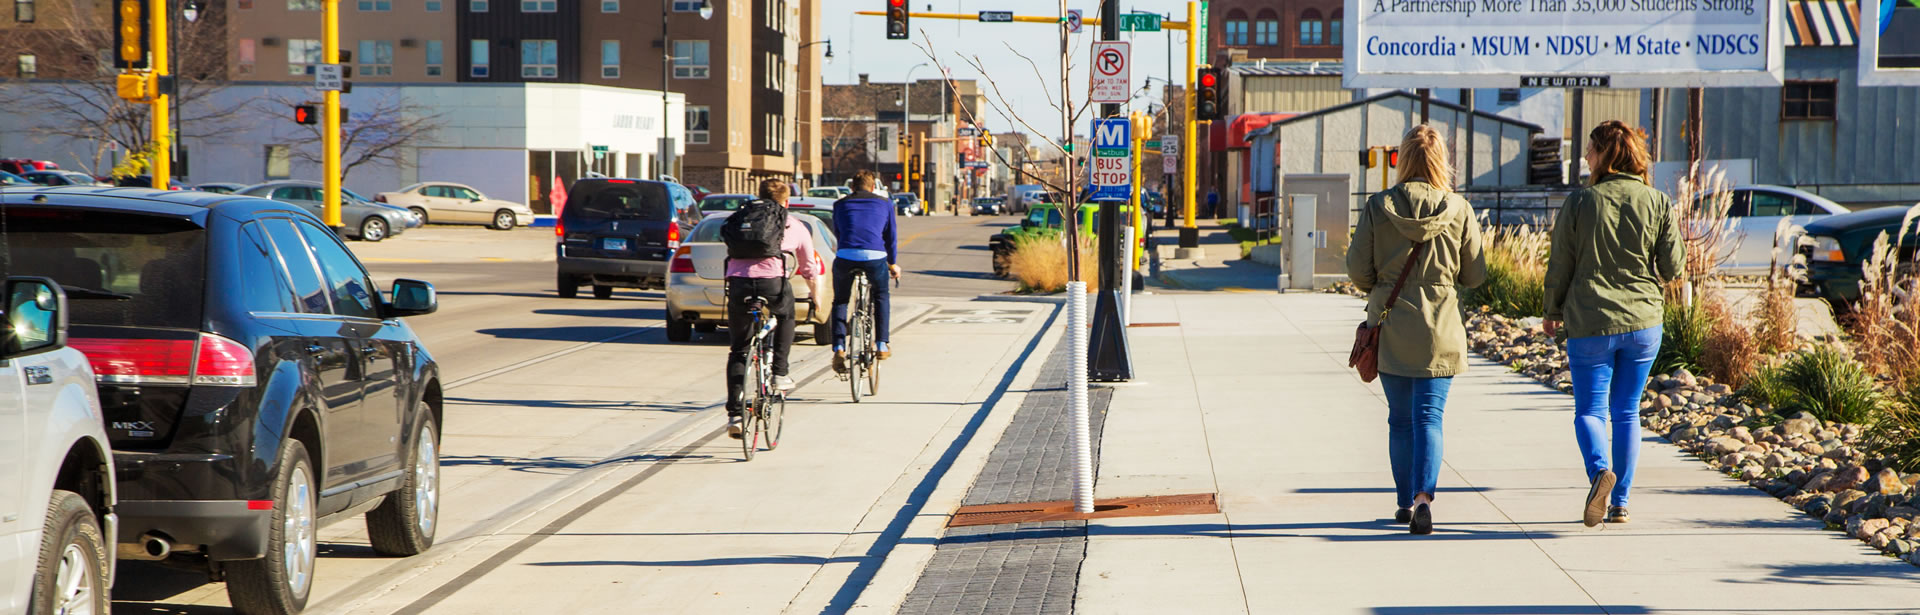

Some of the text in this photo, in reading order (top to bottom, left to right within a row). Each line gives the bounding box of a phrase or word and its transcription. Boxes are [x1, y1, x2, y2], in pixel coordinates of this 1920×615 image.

[1373, 0, 1755, 17] A Partnership More Than 35,000 Students Strong
[1153, 16, 1160, 29] N
[1367, 34, 1759, 56] Concordia MSUM NDSU M State NDSCS
[1529, 77, 1601, 86] NEWMAN
[1097, 124, 1124, 146] M
[1163, 145, 1177, 154] 25
[1098, 158, 1123, 170] BUS
[1092, 172, 1127, 184] STOP
[112, 421, 155, 431] MKX
